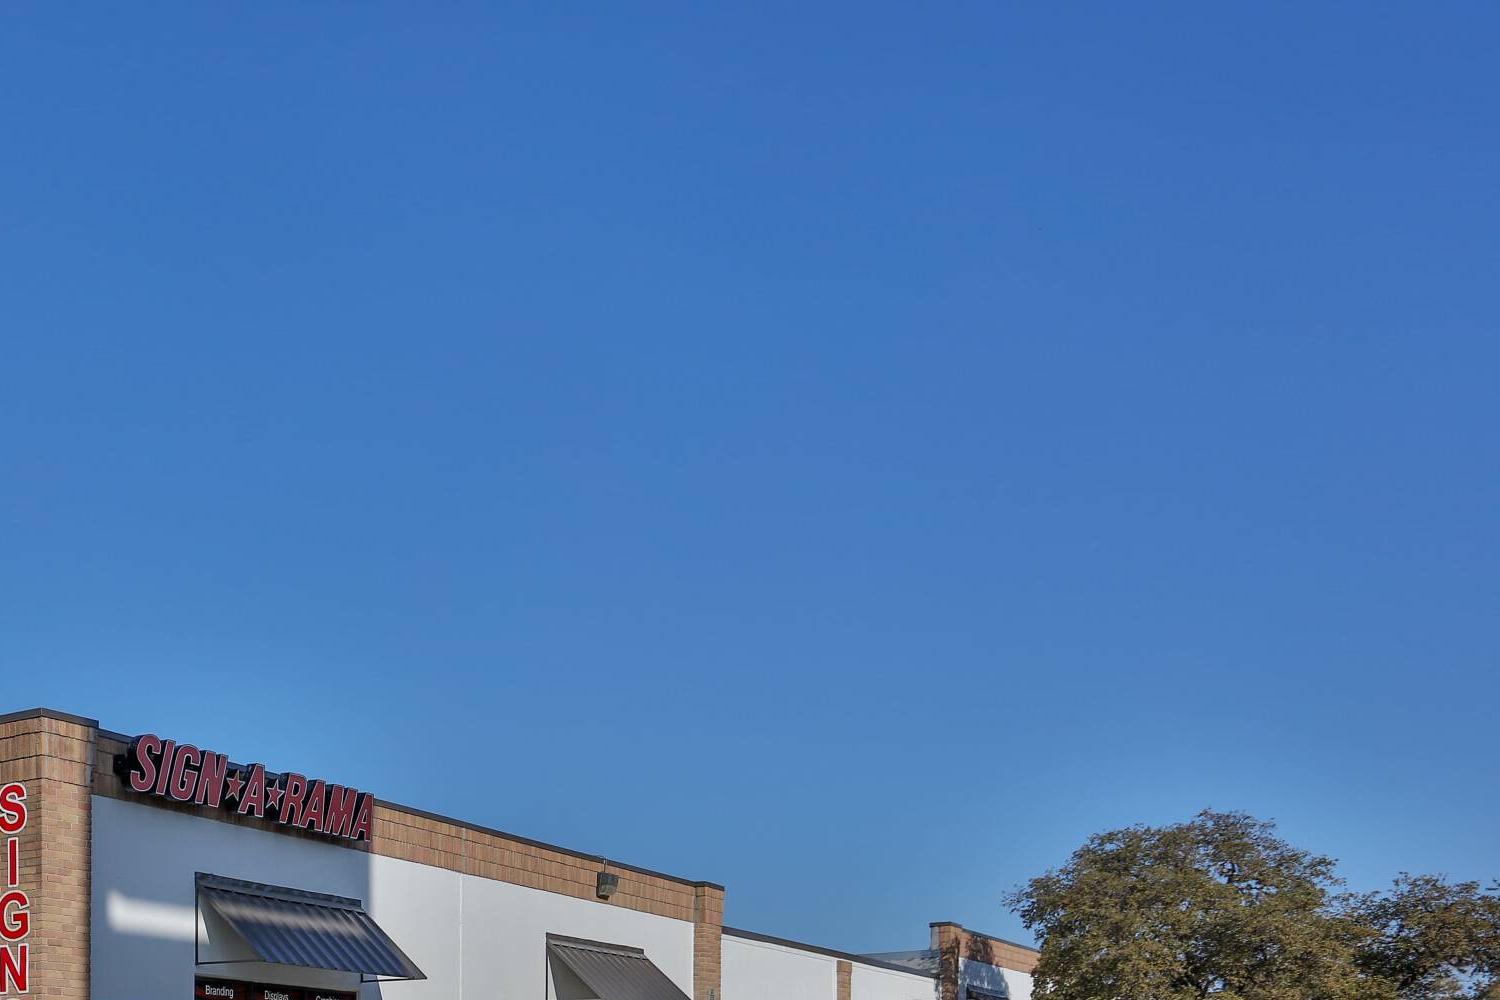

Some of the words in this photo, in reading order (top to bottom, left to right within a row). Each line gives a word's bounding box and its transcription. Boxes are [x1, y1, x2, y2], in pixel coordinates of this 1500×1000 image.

[130, 734, 229, 808] SIGN
[237, 764, 266, 818] A
[279, 772, 374, 841] RAMA
[205, 985, 234, 999] Branding
